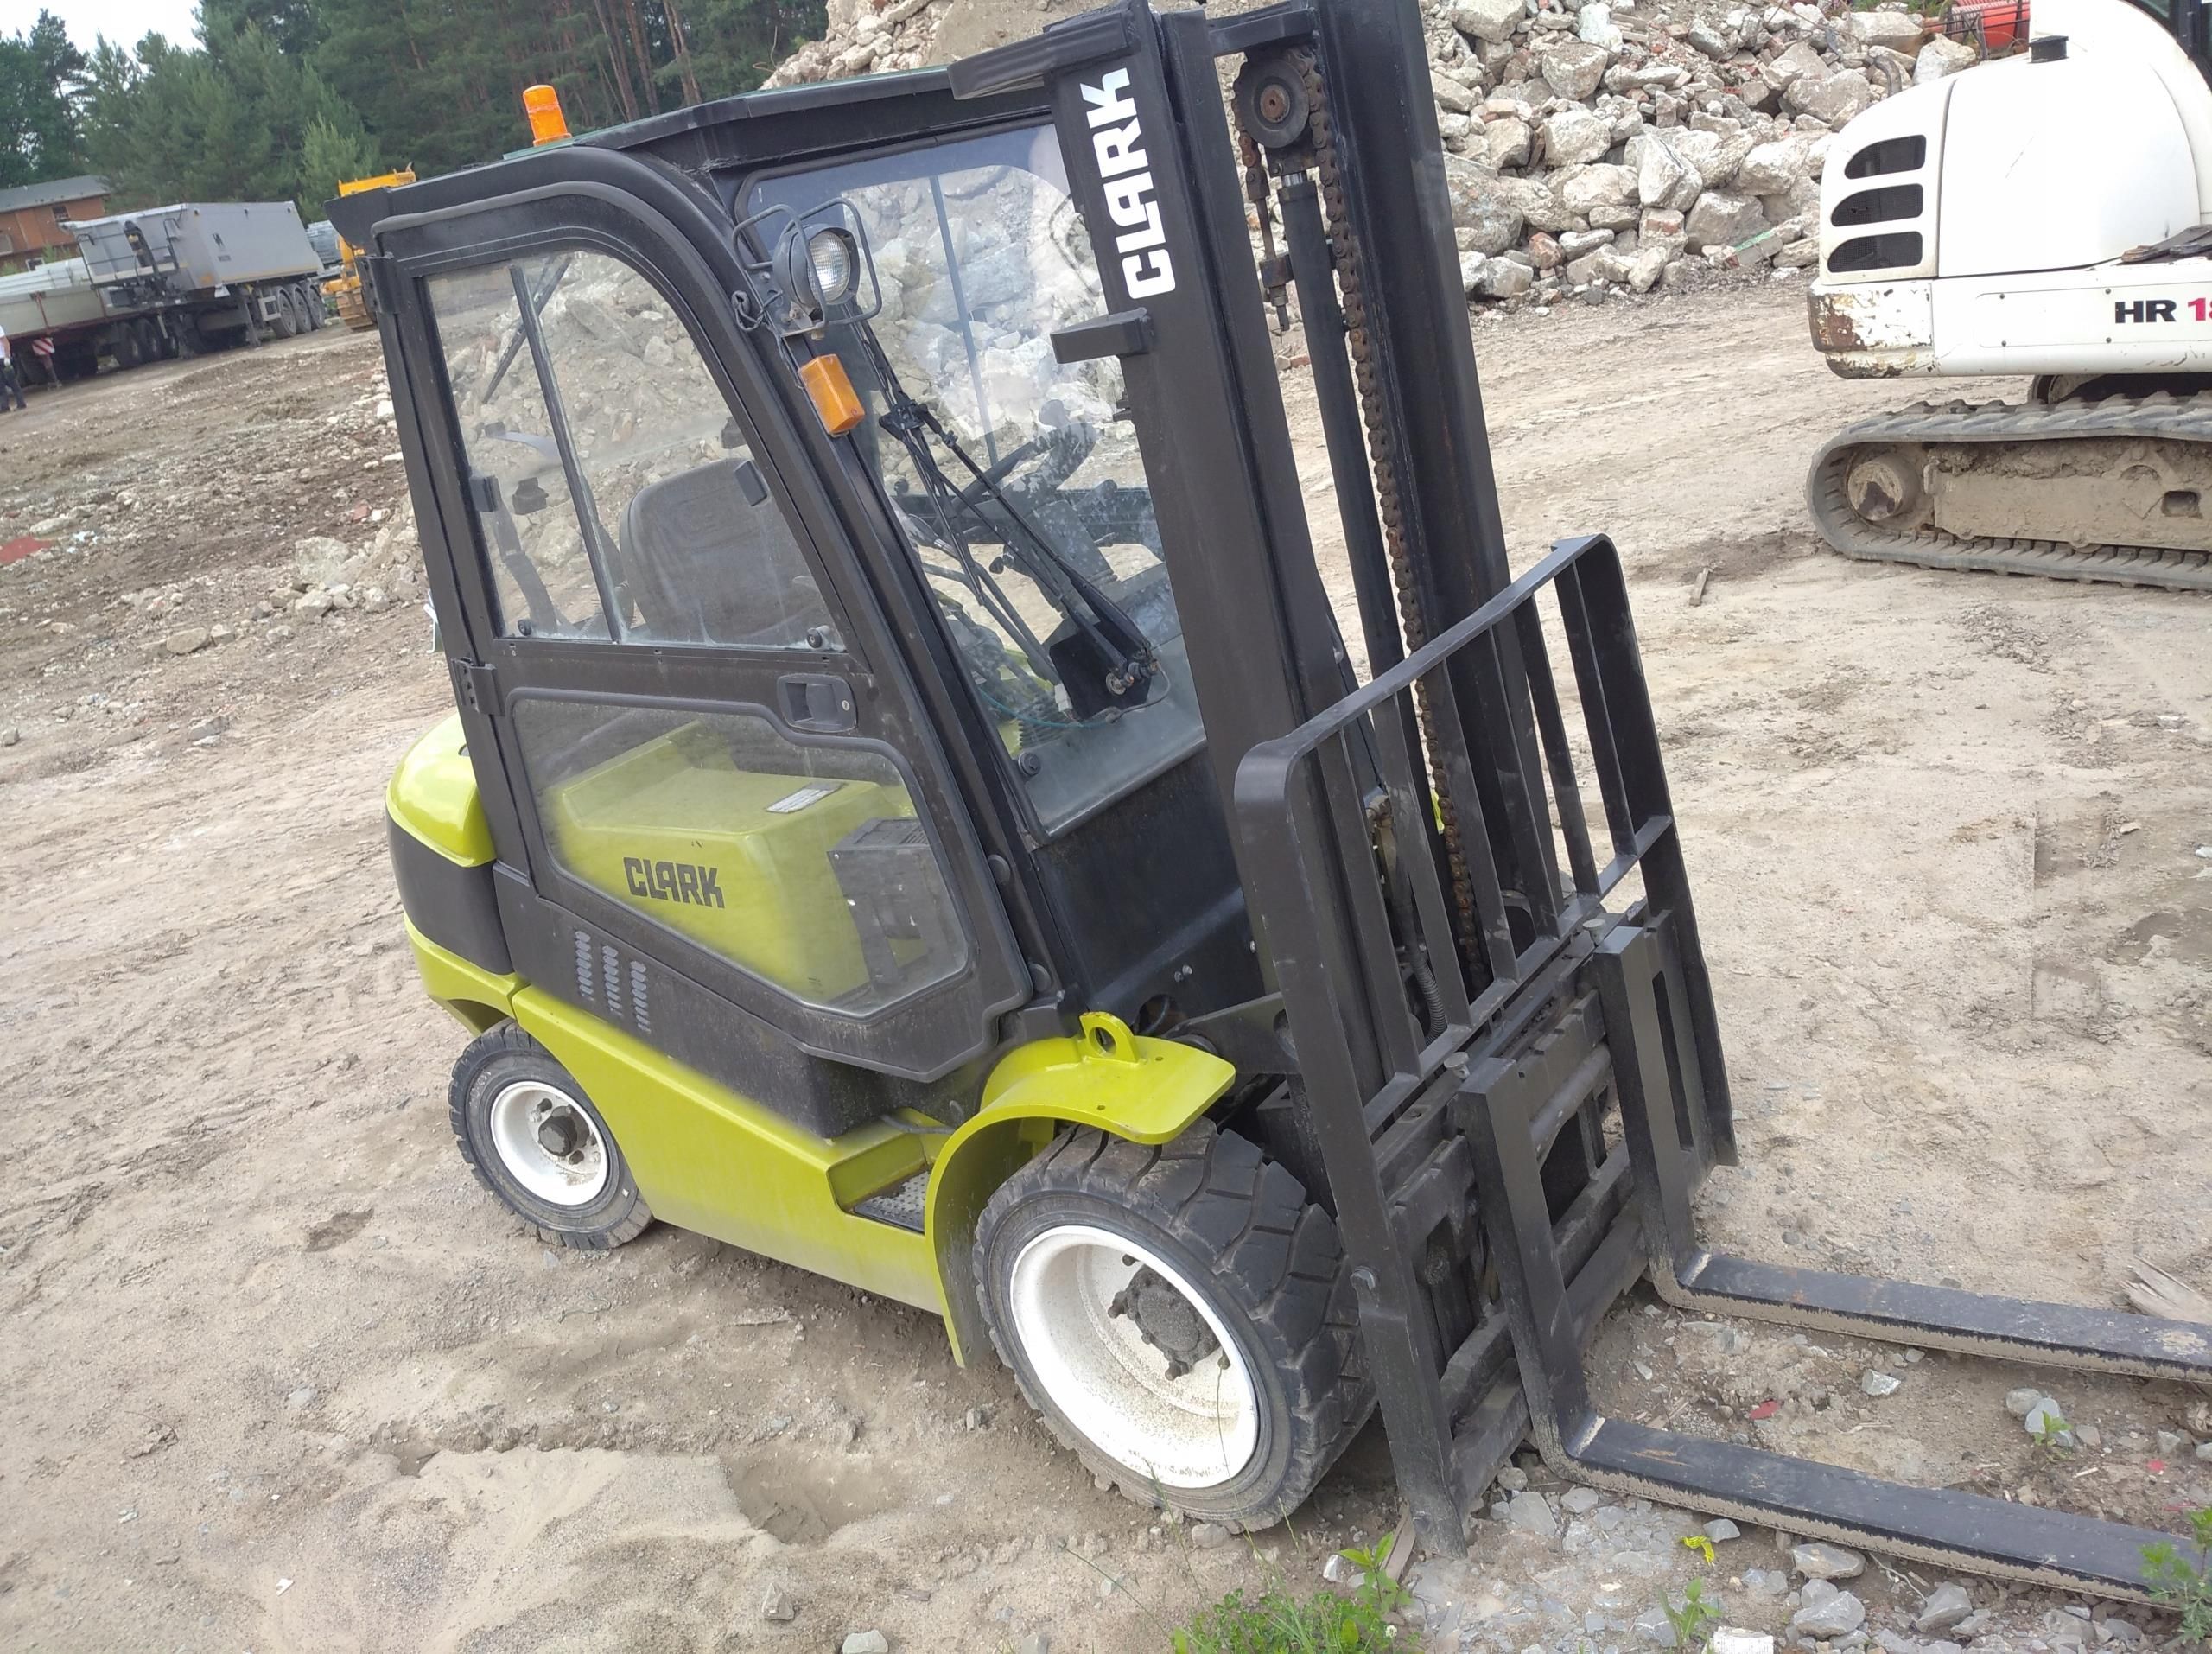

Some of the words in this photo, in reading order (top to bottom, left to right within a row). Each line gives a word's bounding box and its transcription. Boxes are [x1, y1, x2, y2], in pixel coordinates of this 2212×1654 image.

[1080, 67, 1176, 300] CLARK
[2114, 299, 2177, 324] HR
[2187, 297, 2212, 321] 1
[623, 856, 725, 908] CLARK
